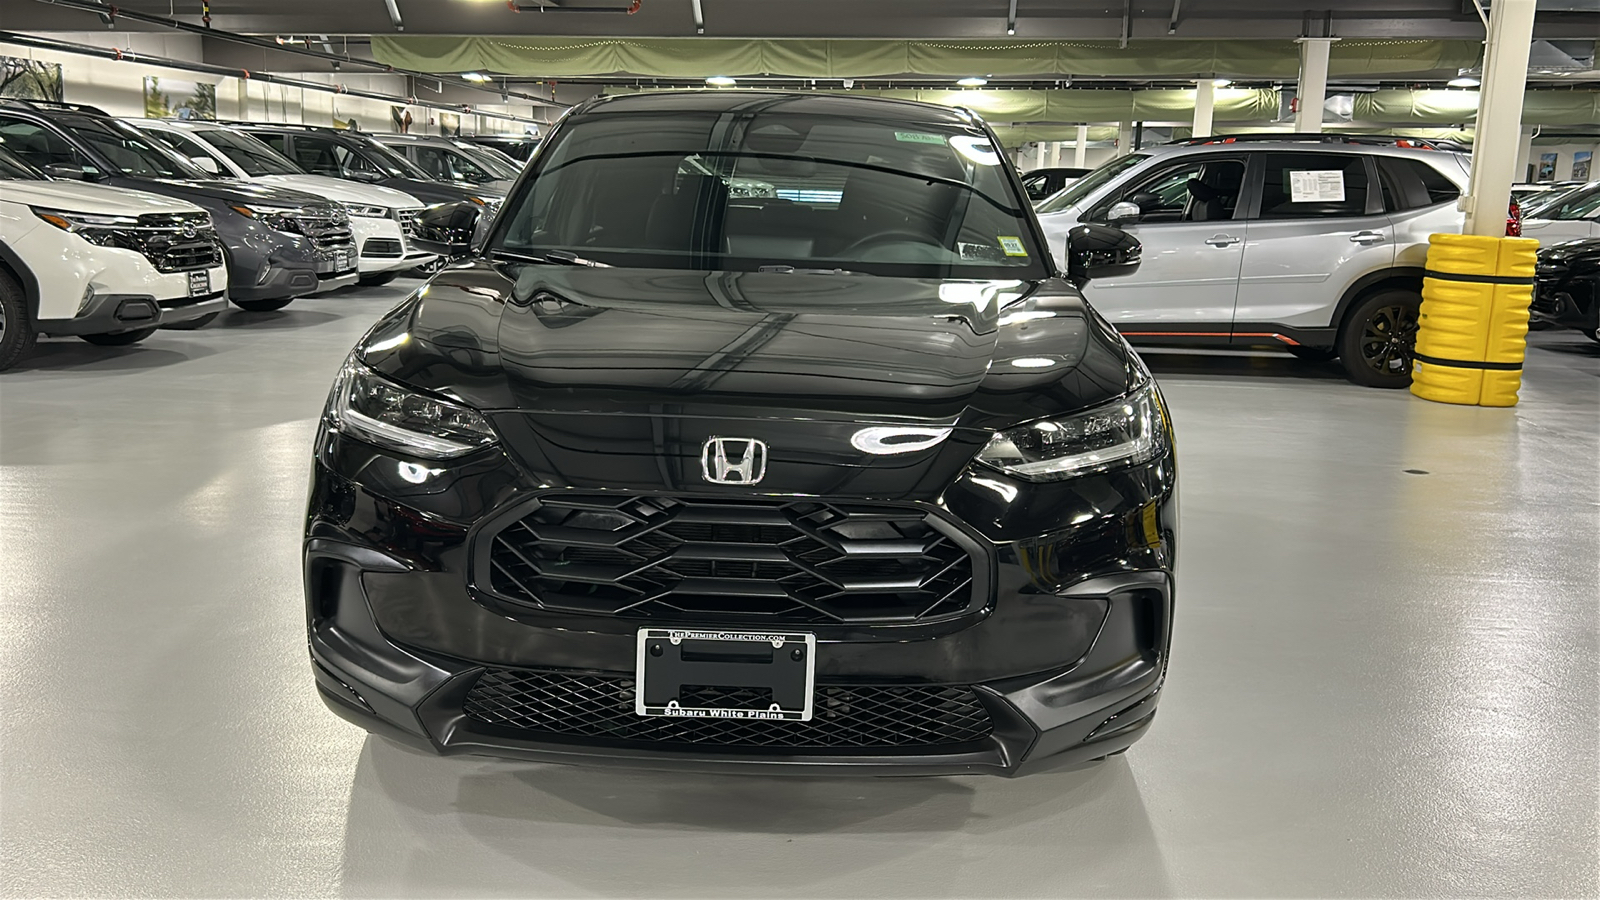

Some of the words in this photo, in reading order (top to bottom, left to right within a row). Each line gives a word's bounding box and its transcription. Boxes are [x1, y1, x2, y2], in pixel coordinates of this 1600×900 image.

[664, 708, 706, 717] Subaru
[710, 709, 744, 718] White
[748, 711, 784, 720] Plains
